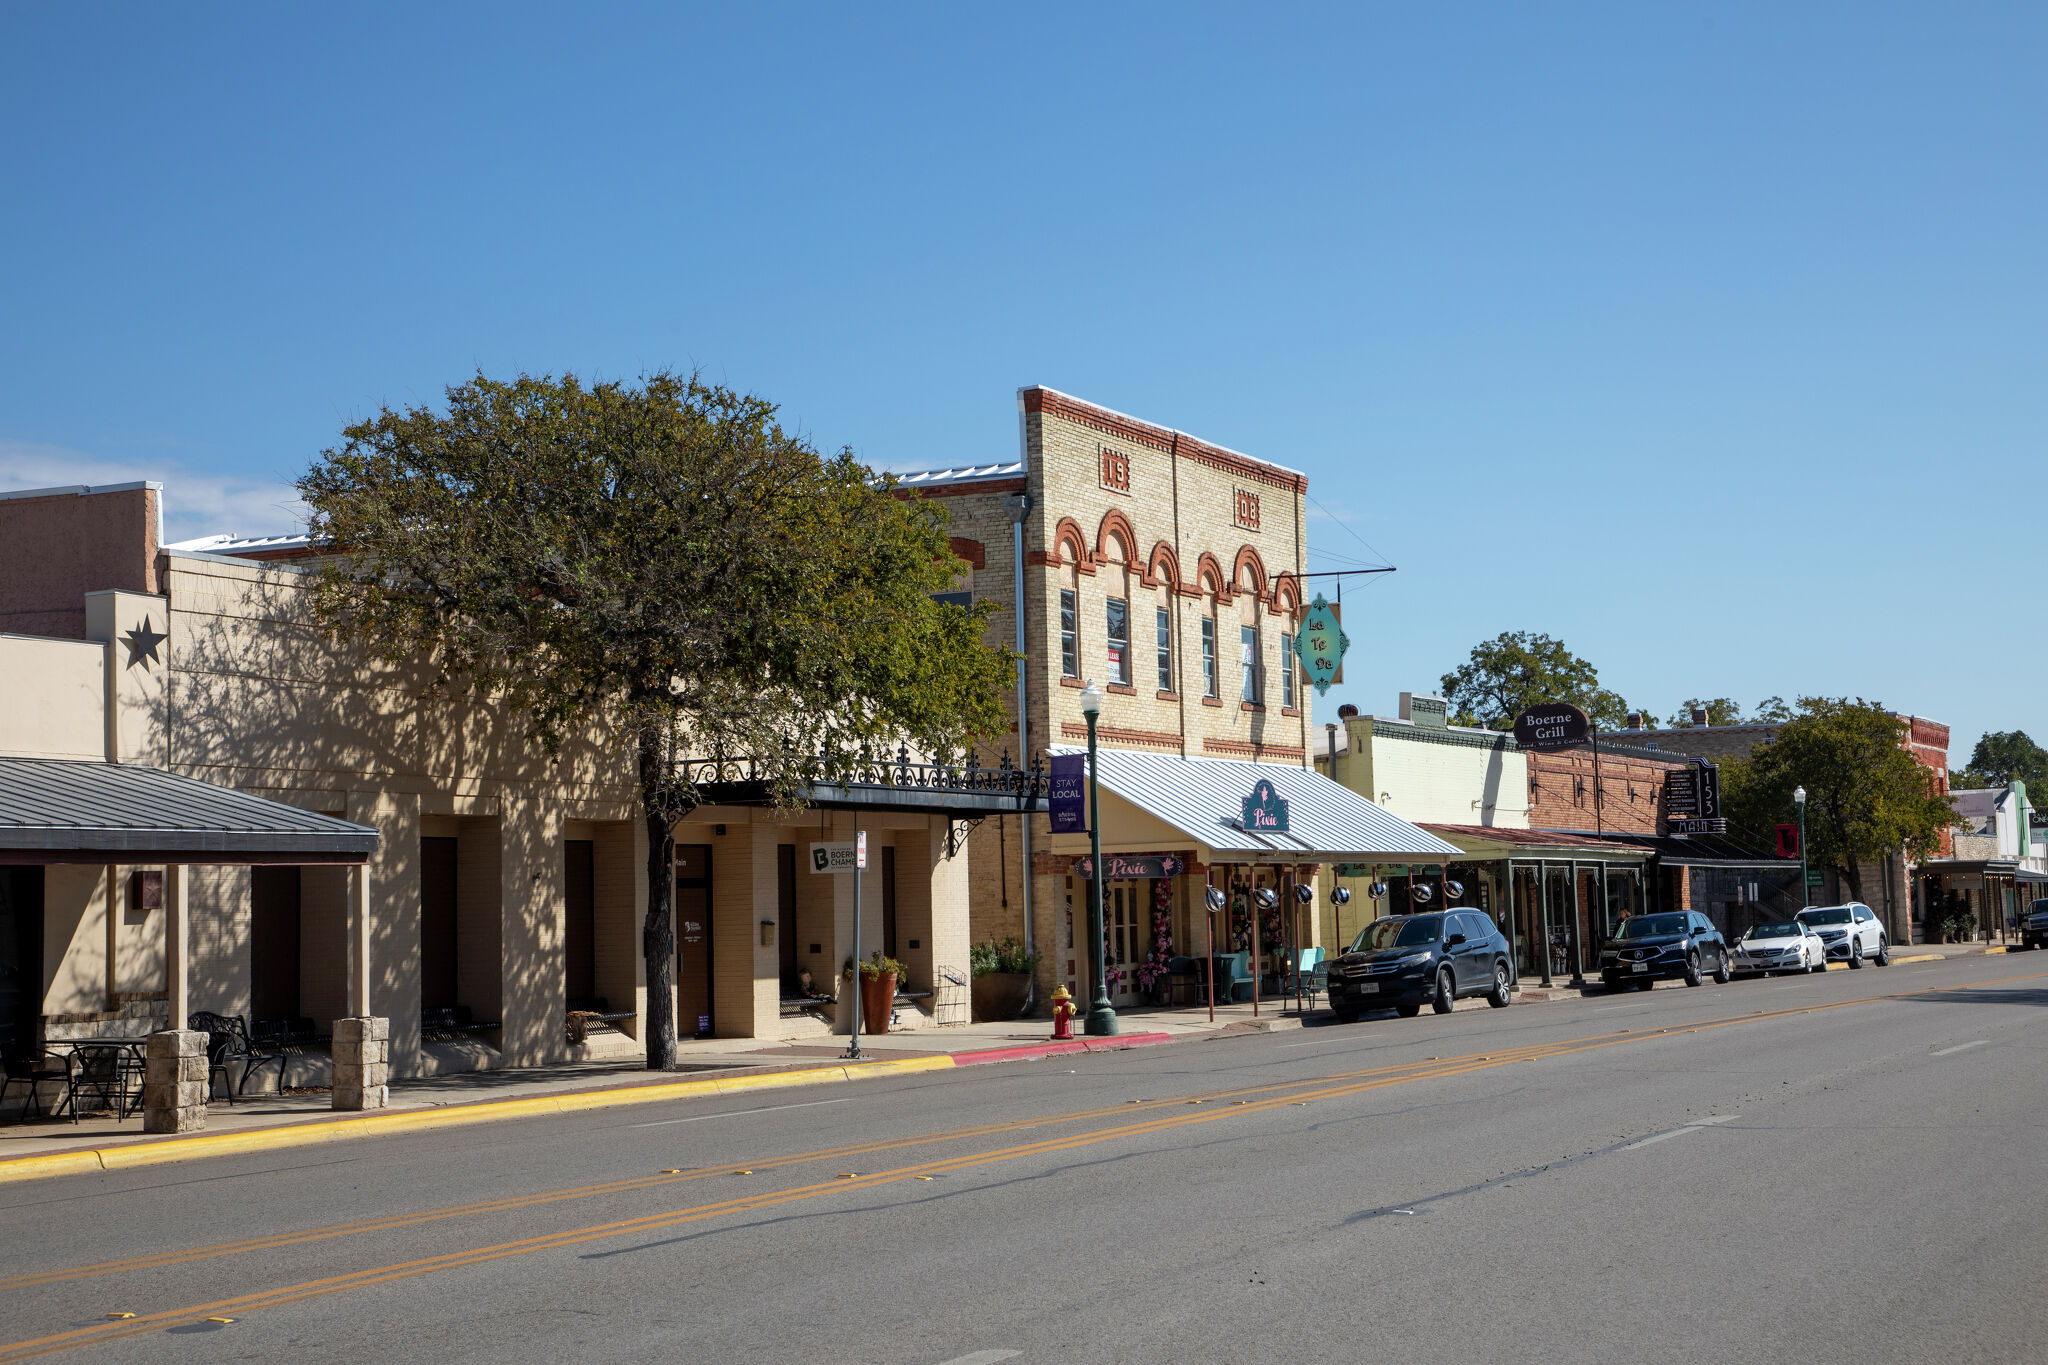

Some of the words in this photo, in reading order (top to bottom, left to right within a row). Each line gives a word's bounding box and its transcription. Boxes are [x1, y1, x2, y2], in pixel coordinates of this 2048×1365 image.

[1108, 459, 1124, 482] 19
[1240, 499, 1256, 520] 08
[1308, 618, 1325, 630] La
[1311, 637, 1327, 651] Te
[1315, 657, 1333, 670] Da
[1526, 714, 1572, 726] Boerne
[1535, 725, 1565, 739] Grill
[1056, 778, 1077, 788] STAY
[1052, 789, 1081, 799] LOCAL
[1704, 771, 1714, 814] 153
[1253, 808, 1278, 827] Pixie
[1678, 820, 1708, 832] MAIN
[830, 850, 856, 859] BOERN
[1108, 858, 1149, 877] Pixie
